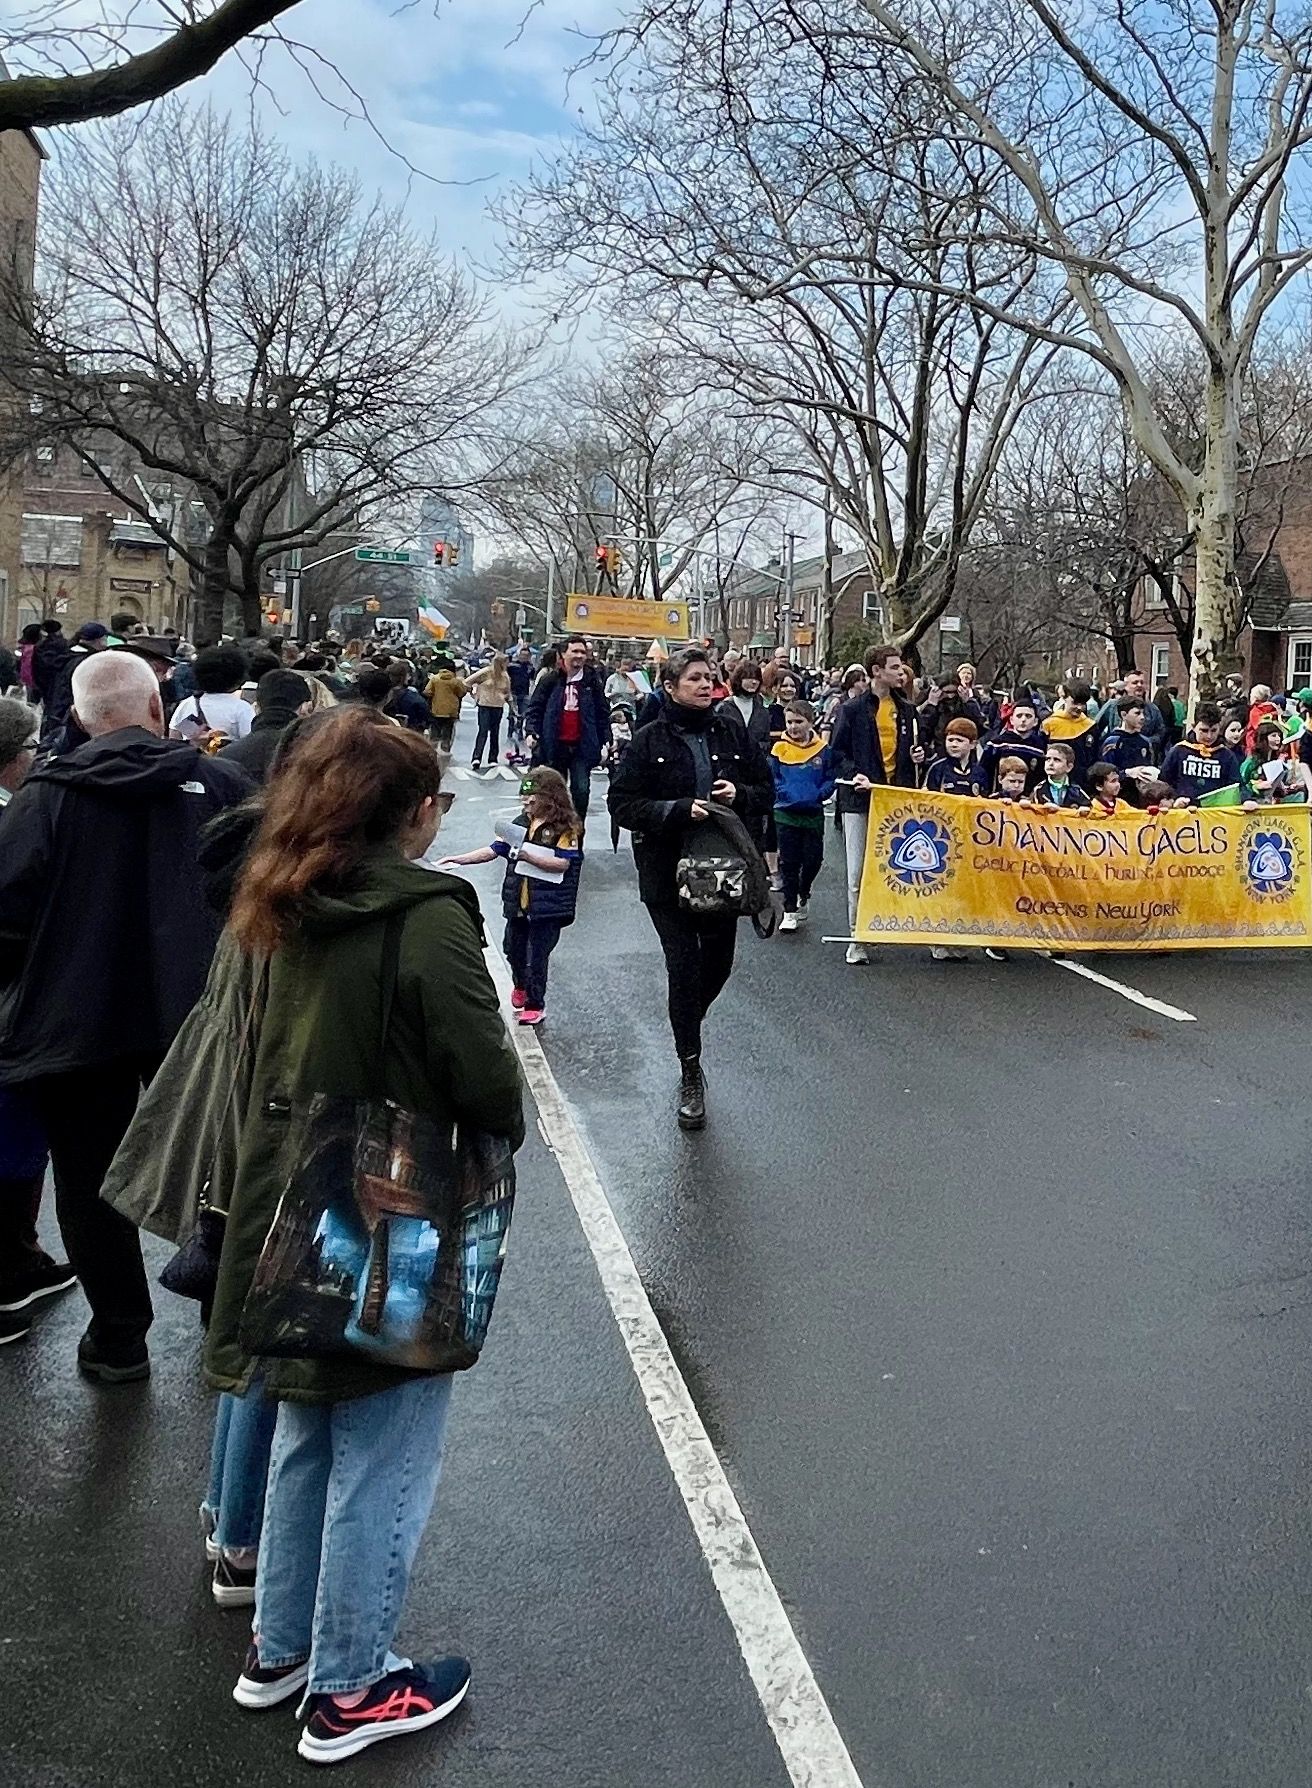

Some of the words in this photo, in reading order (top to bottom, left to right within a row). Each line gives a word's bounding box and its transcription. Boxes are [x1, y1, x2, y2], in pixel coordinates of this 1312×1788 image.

[1182, 760, 1221, 778] IRISH
[874, 803, 913, 858] SHANNON
[917, 803, 955, 827] GAELS
[884, 874, 911, 897] NEW
[914, 878, 950, 899] YORK
